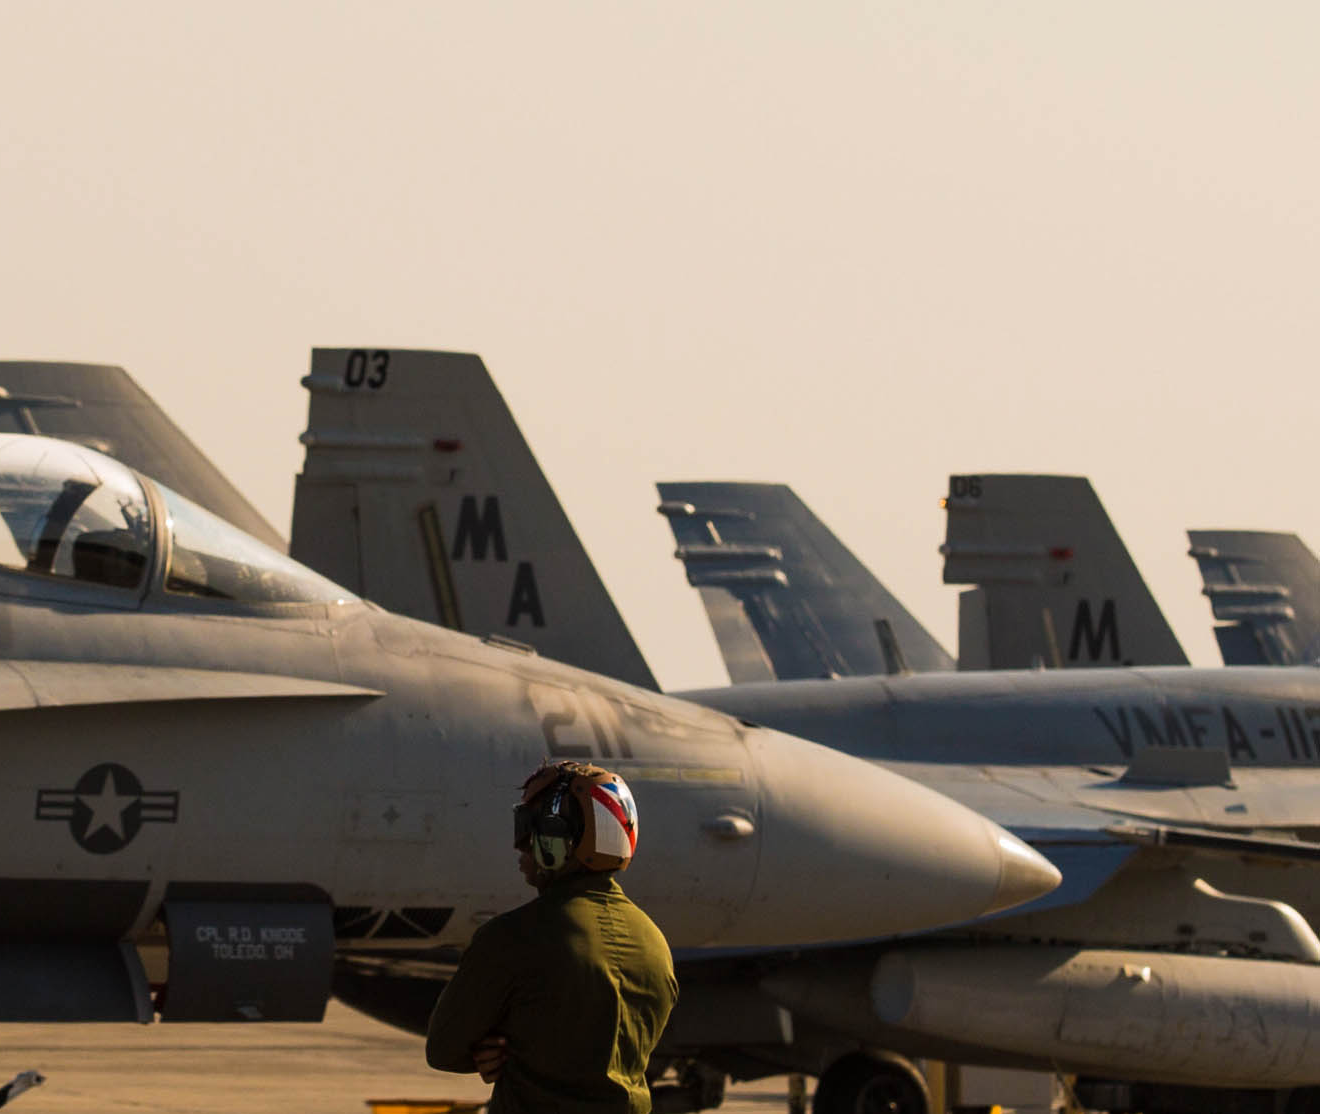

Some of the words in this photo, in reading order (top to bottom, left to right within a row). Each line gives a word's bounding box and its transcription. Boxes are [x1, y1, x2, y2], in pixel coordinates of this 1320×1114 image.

[345, 350, 389, 389] 03
[452, 495, 508, 562] M
[506, 561, 545, 628] A
[1093, 705, 1320, 760] VMFA-11
